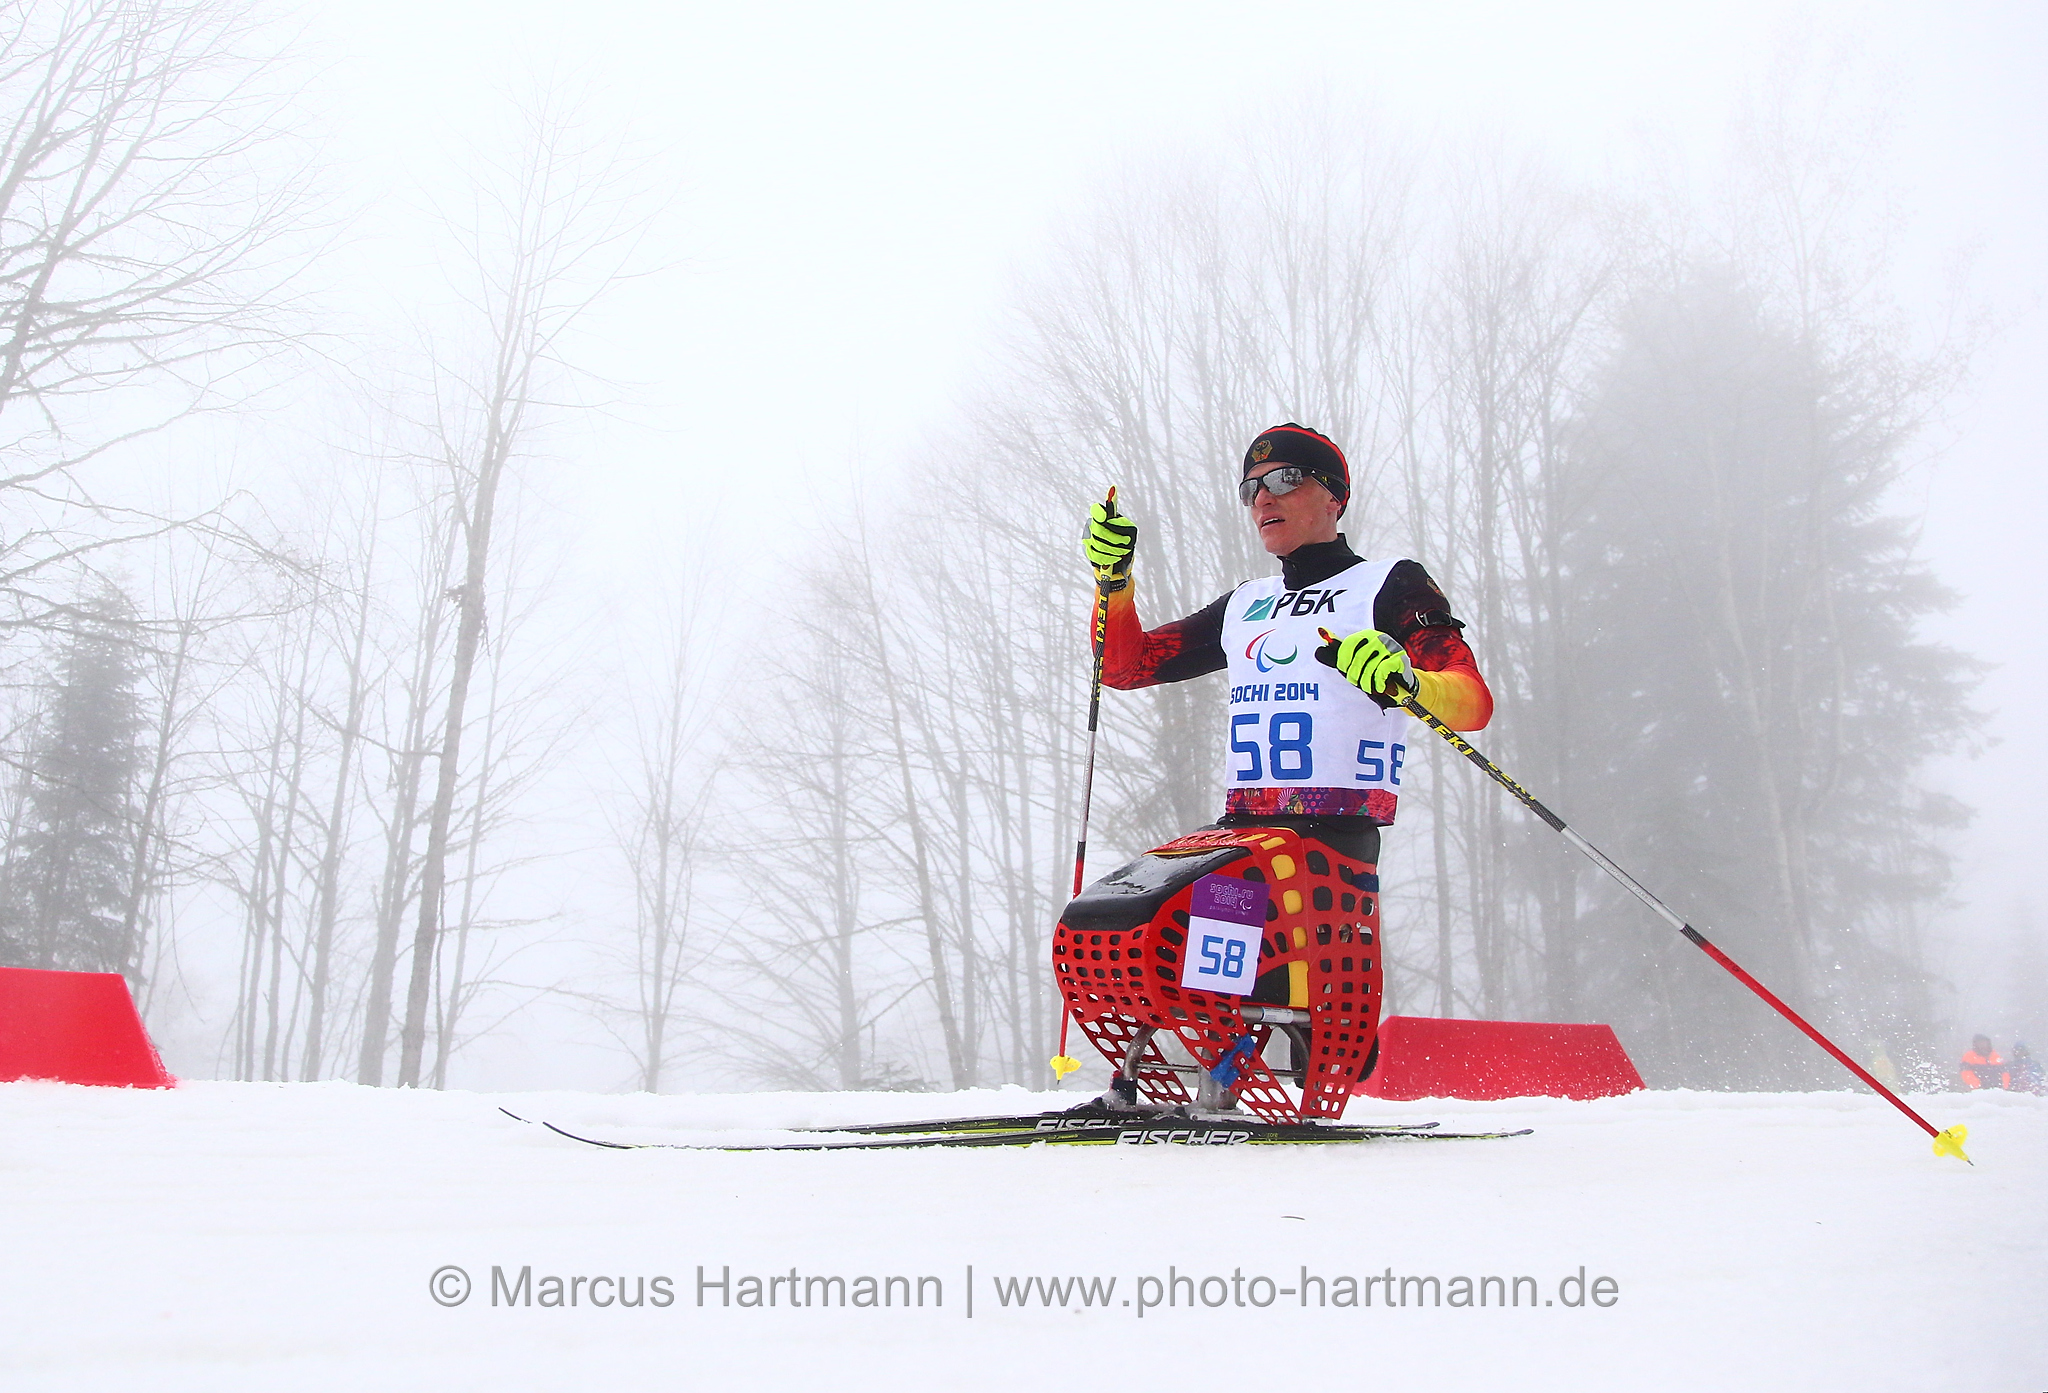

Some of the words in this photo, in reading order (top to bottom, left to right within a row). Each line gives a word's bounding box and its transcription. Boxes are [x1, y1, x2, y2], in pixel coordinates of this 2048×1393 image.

[1096, 594, 1108, 642] LEKI
[1271, 589, 1347, 620] РБК
[1230, 684, 1269, 705] SOCHI
[1274, 682, 1318, 701] 2014
[1230, 712, 1313, 781] 58
[1420, 714, 1474, 756] LEKI
[1355, 739, 1406, 785] 58
[1210, 883, 1254, 899] sochi.ru
[1198, 935, 1246, 978] 58
[1116, 1130, 1250, 1145] FISCHER
